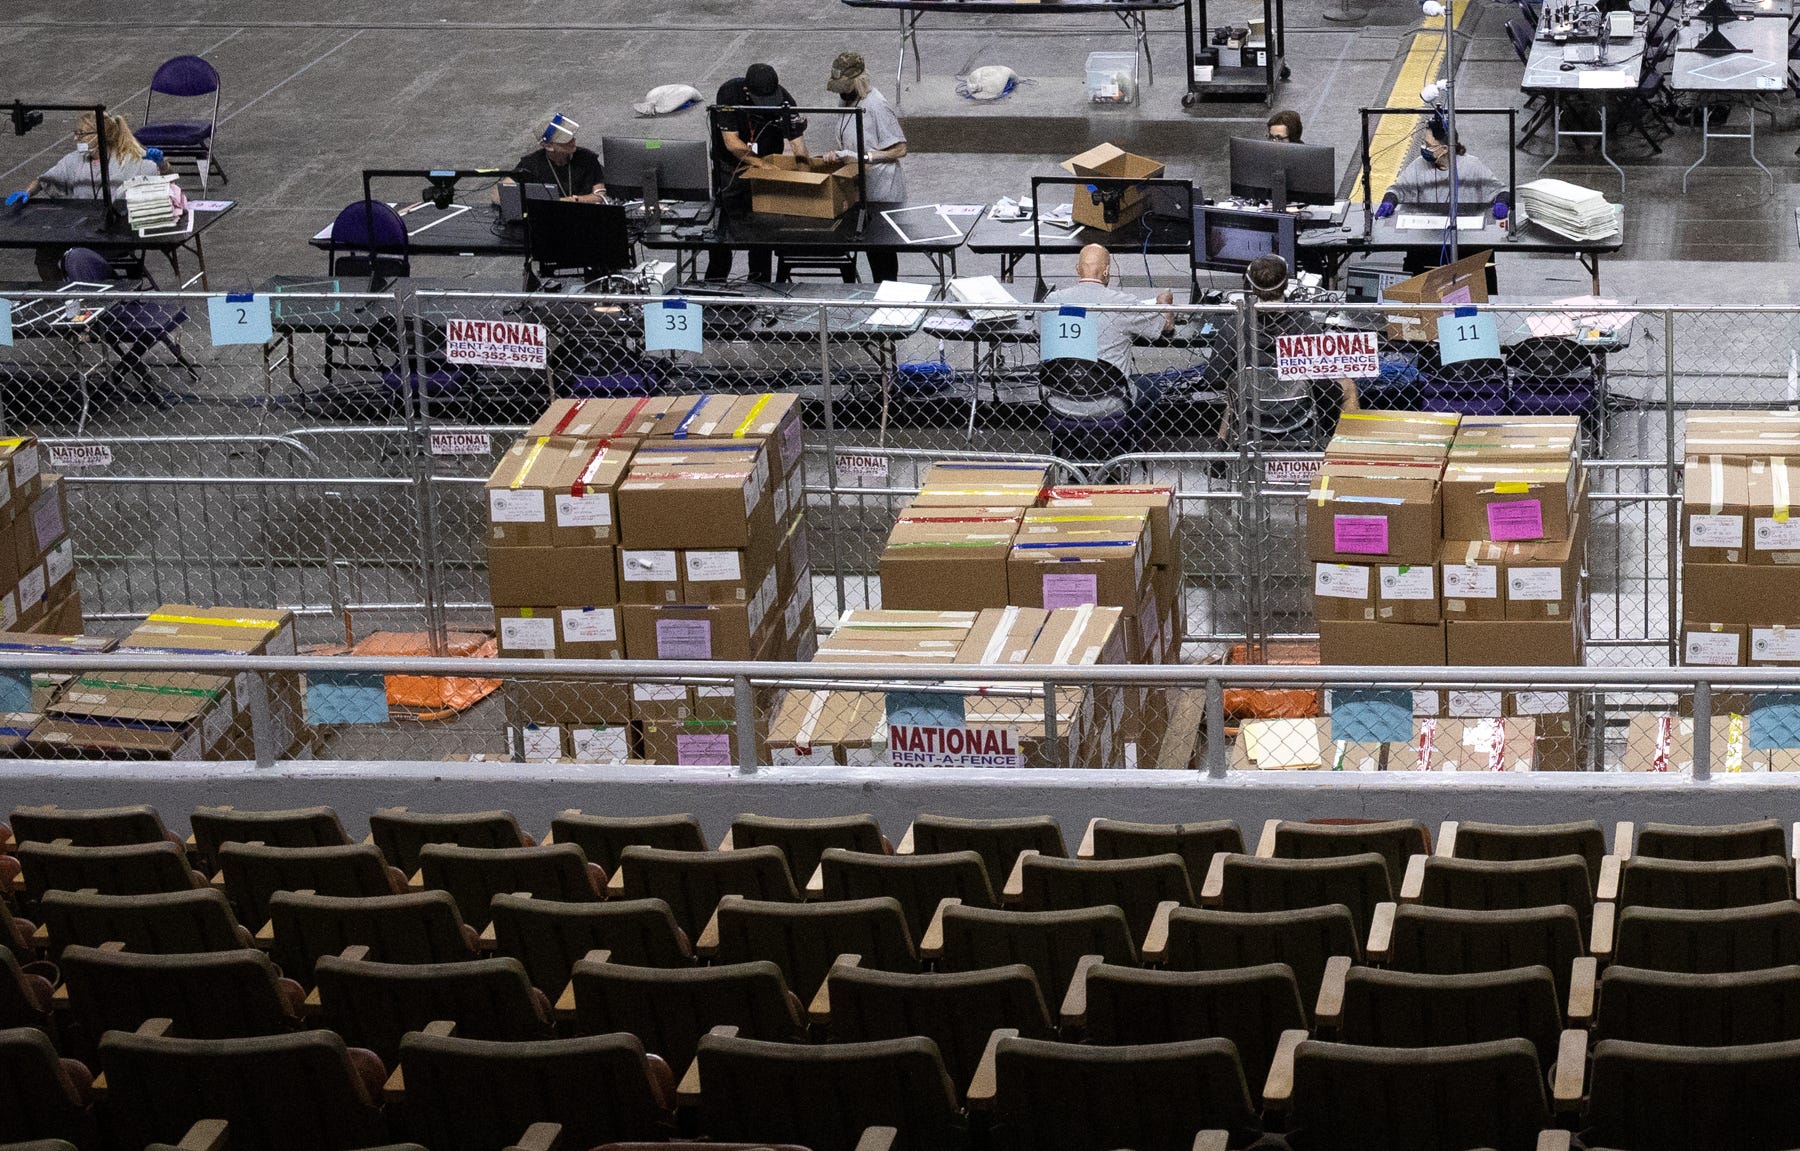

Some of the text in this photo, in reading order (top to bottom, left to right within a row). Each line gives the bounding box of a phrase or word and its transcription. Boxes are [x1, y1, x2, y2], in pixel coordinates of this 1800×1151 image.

[236, 308, 248, 324] 2
[665, 315, 688, 331] 33
[449, 321, 544, 346] NATIONAL
[1059, 323, 1081, 339] 19
[1457, 324, 1480, 341] 11
[449, 342, 543, 354] RENT-A-FENCE
[1279, 334, 1375, 357] NATIONAL
[1280, 356, 1376, 366] RENT-A-FENCE
[1281, 364, 1376, 375] 800-352-5675
[432, 435, 488, 445] NATIONAL
[53, 446, 107, 458] NATIONAL
[891, 725, 1015, 755] NATIONAL
[892, 752, 1016, 765] RENT-A-FENCE
